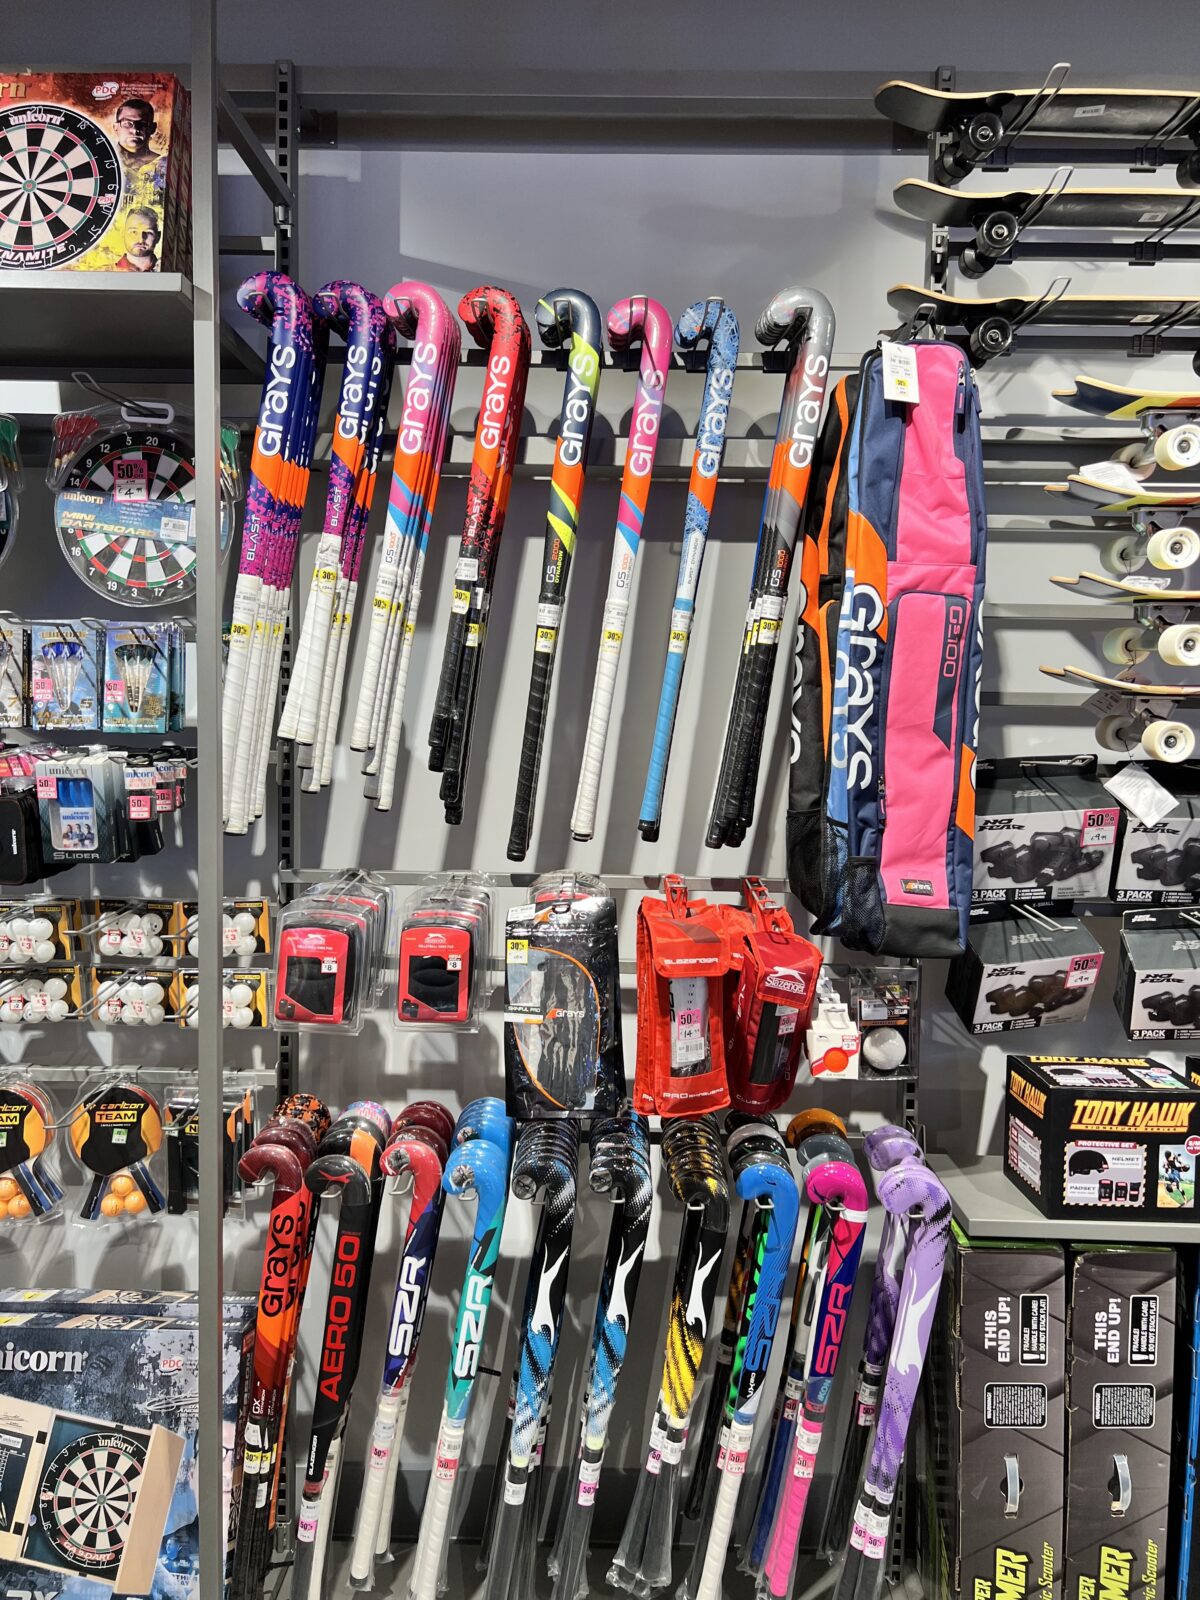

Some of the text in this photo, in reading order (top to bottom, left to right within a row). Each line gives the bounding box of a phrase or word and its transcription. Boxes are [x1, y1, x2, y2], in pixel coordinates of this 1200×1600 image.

[95, 86, 117, 94] PDC
[9, 113, 62, 125] unicorn
[126, 436, 133, 446] 5
[146, 436, 159, 446] 20
[100, 444, 111, 453] 12
[86, 459, 93, 468] 9
[70, 478, 81, 487] 14
[63, 492, 104, 505] unicorn
[331, 486, 343, 527] BLAST
[467, 496, 482, 538] BLAST
[61, 519, 157, 538] DARTBOARD
[246, 514, 261, 561] BLAST
[71, 547, 81, 557] 16
[546, 538, 560, 583] GS 2000
[89, 567, 96, 576] 7
[554, 550, 564, 583] DYNABOW
[770, 569, 781, 587] GS
[107, 581, 118, 591] 19
[131, 588, 138, 597] 3
[154, 587, 165, 598] 17
[53, 851, 100, 860] SLIDER
[972, 889, 1006, 899] 3 PACK
[1117, 890, 1153, 899] 3 PACK
[765, 975, 806, 994] Slazenger
[981, 1021, 1004, 1031] PACK
[100, 1101, 145, 1110] carlton
[97, 1112, 136, 1121] TEAM
[1072, 1099, 1197, 1127] TONY HAWK
[1078, 1140, 1120, 1148] PROTECTIVE
[319, 1234, 361, 1403] AERO 50
[984, 1309, 998, 1350] THIS
[998, 1296, 1011, 1363] END UP!
[1094, 1311, 1108, 1351] THIS
[1107, 1297, 1122, 1364] END UP!
[1140, 1331, 1148, 1352] HANDLE
[1039, 1343, 1046, 1352] DO
[1148, 1343, 1155, 1352] DO
[162, 1359, 182, 1368] PDC
[98, 1438, 134, 1454] unicorn
[308, 1434, 318, 1476] SLAZENGER
